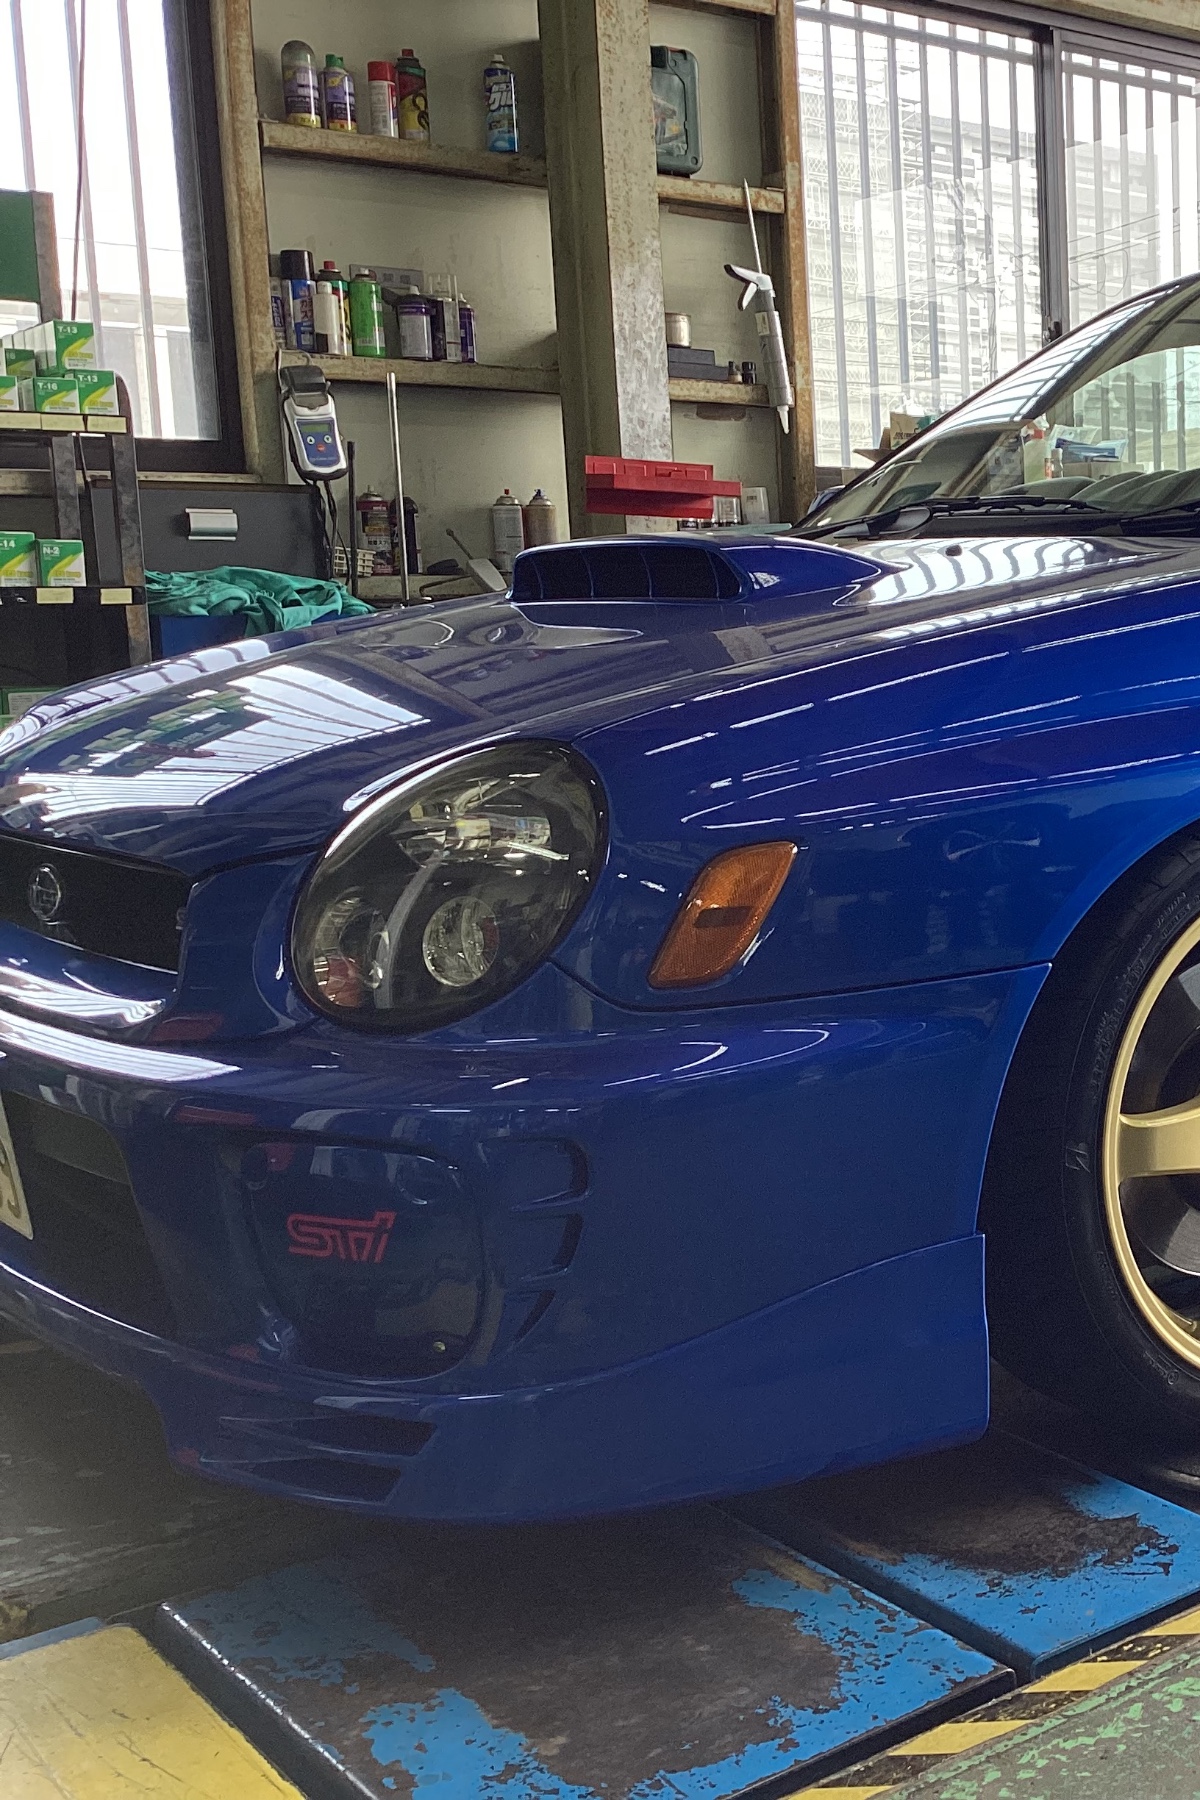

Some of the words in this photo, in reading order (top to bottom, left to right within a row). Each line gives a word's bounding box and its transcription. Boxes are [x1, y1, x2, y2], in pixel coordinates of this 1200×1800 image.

[57, 325, 78, 334] T-13
[77, 374, 98, 383] T-13
[42, 546, 60, 555] N-2
